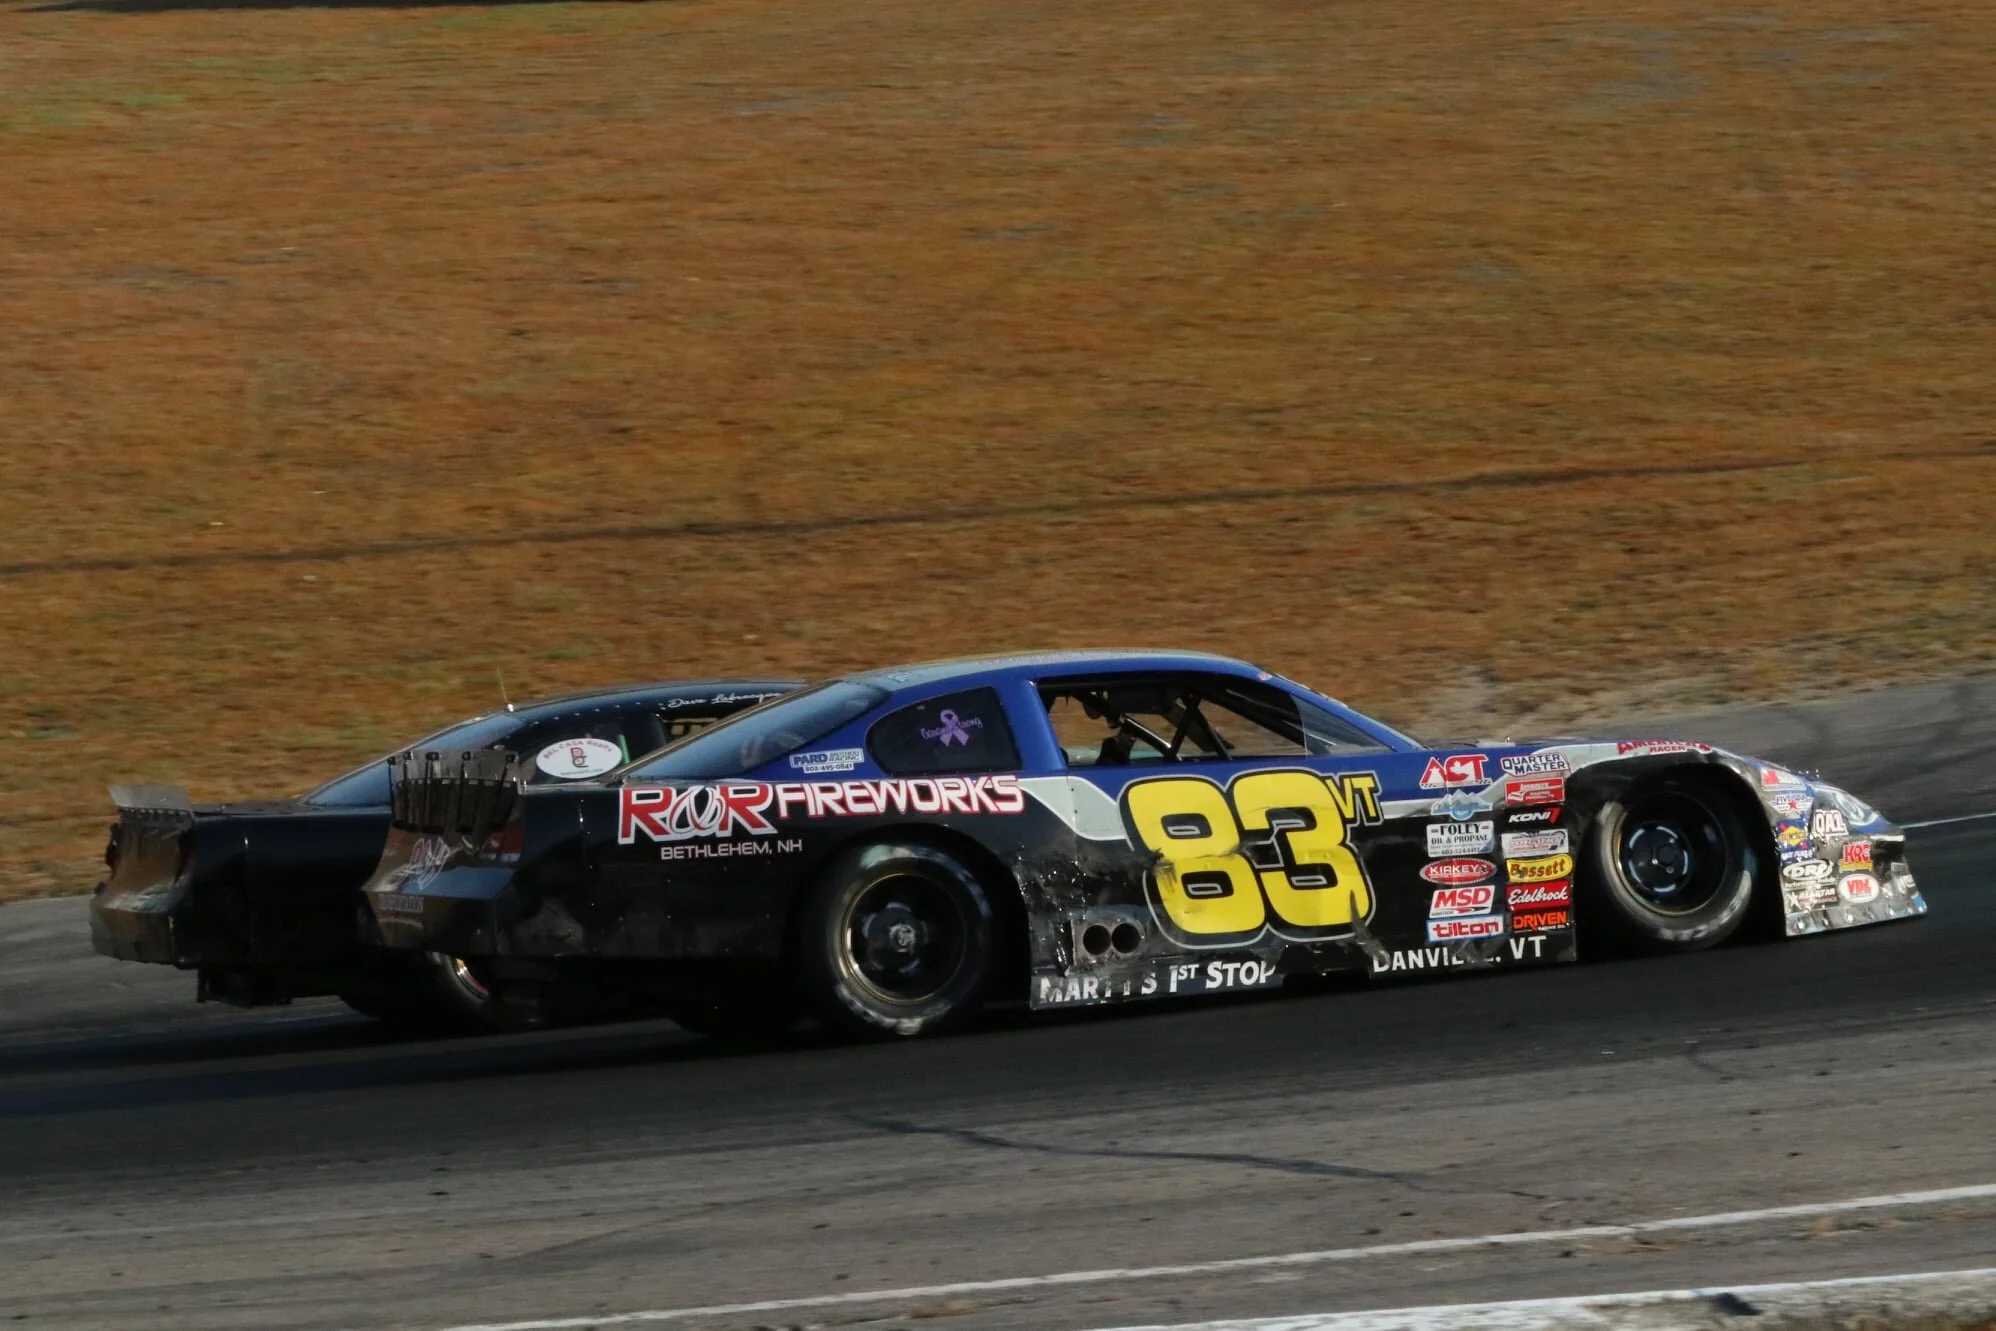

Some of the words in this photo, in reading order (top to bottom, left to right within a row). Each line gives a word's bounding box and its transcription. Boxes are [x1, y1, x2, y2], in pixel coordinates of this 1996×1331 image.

[1502, 754, 1561, 770] QUARTER
[1514, 761, 1566, 775] MASTER
[775, 776, 1027, 819] FIREWORKS
[1326, 770, 1384, 826] VT
[1508, 811, 1552, 823] KONI
[1814, 811, 1846, 838] QA1
[1440, 823, 1480, 835] FOLEY
[661, 842, 773, 861] BETHLEHEM,
[777, 839, 803, 853] NH
[1120, 768, 1376, 948] 83
[1429, 864, 1480, 875] KIRKEY
[1510, 858, 1566, 878] Bassett
[1434, 887, 1492, 909] MSD
[1508, 886, 1568, 905] Edelbrock
[1432, 921, 1500, 938] tilton
[1512, 911, 1567, 931] DRIVEN
[1509, 935, 1548, 960] VT
